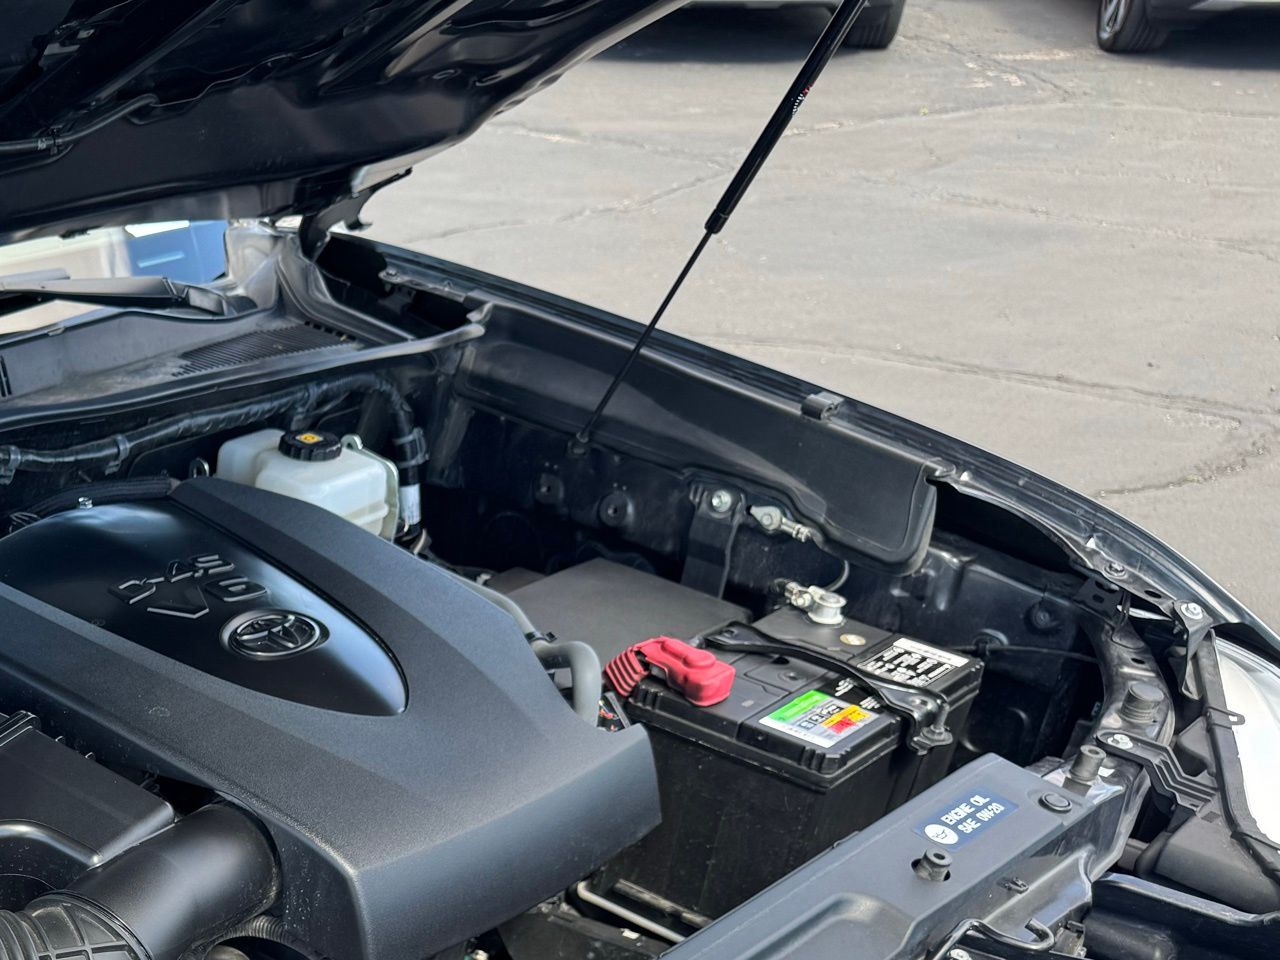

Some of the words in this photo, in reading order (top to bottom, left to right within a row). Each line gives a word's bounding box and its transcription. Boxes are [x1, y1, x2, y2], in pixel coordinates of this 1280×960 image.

[147, 576, 269, 619] V6
[940, 802, 976, 826] ENGINE
[957, 817, 982, 834] SAE
